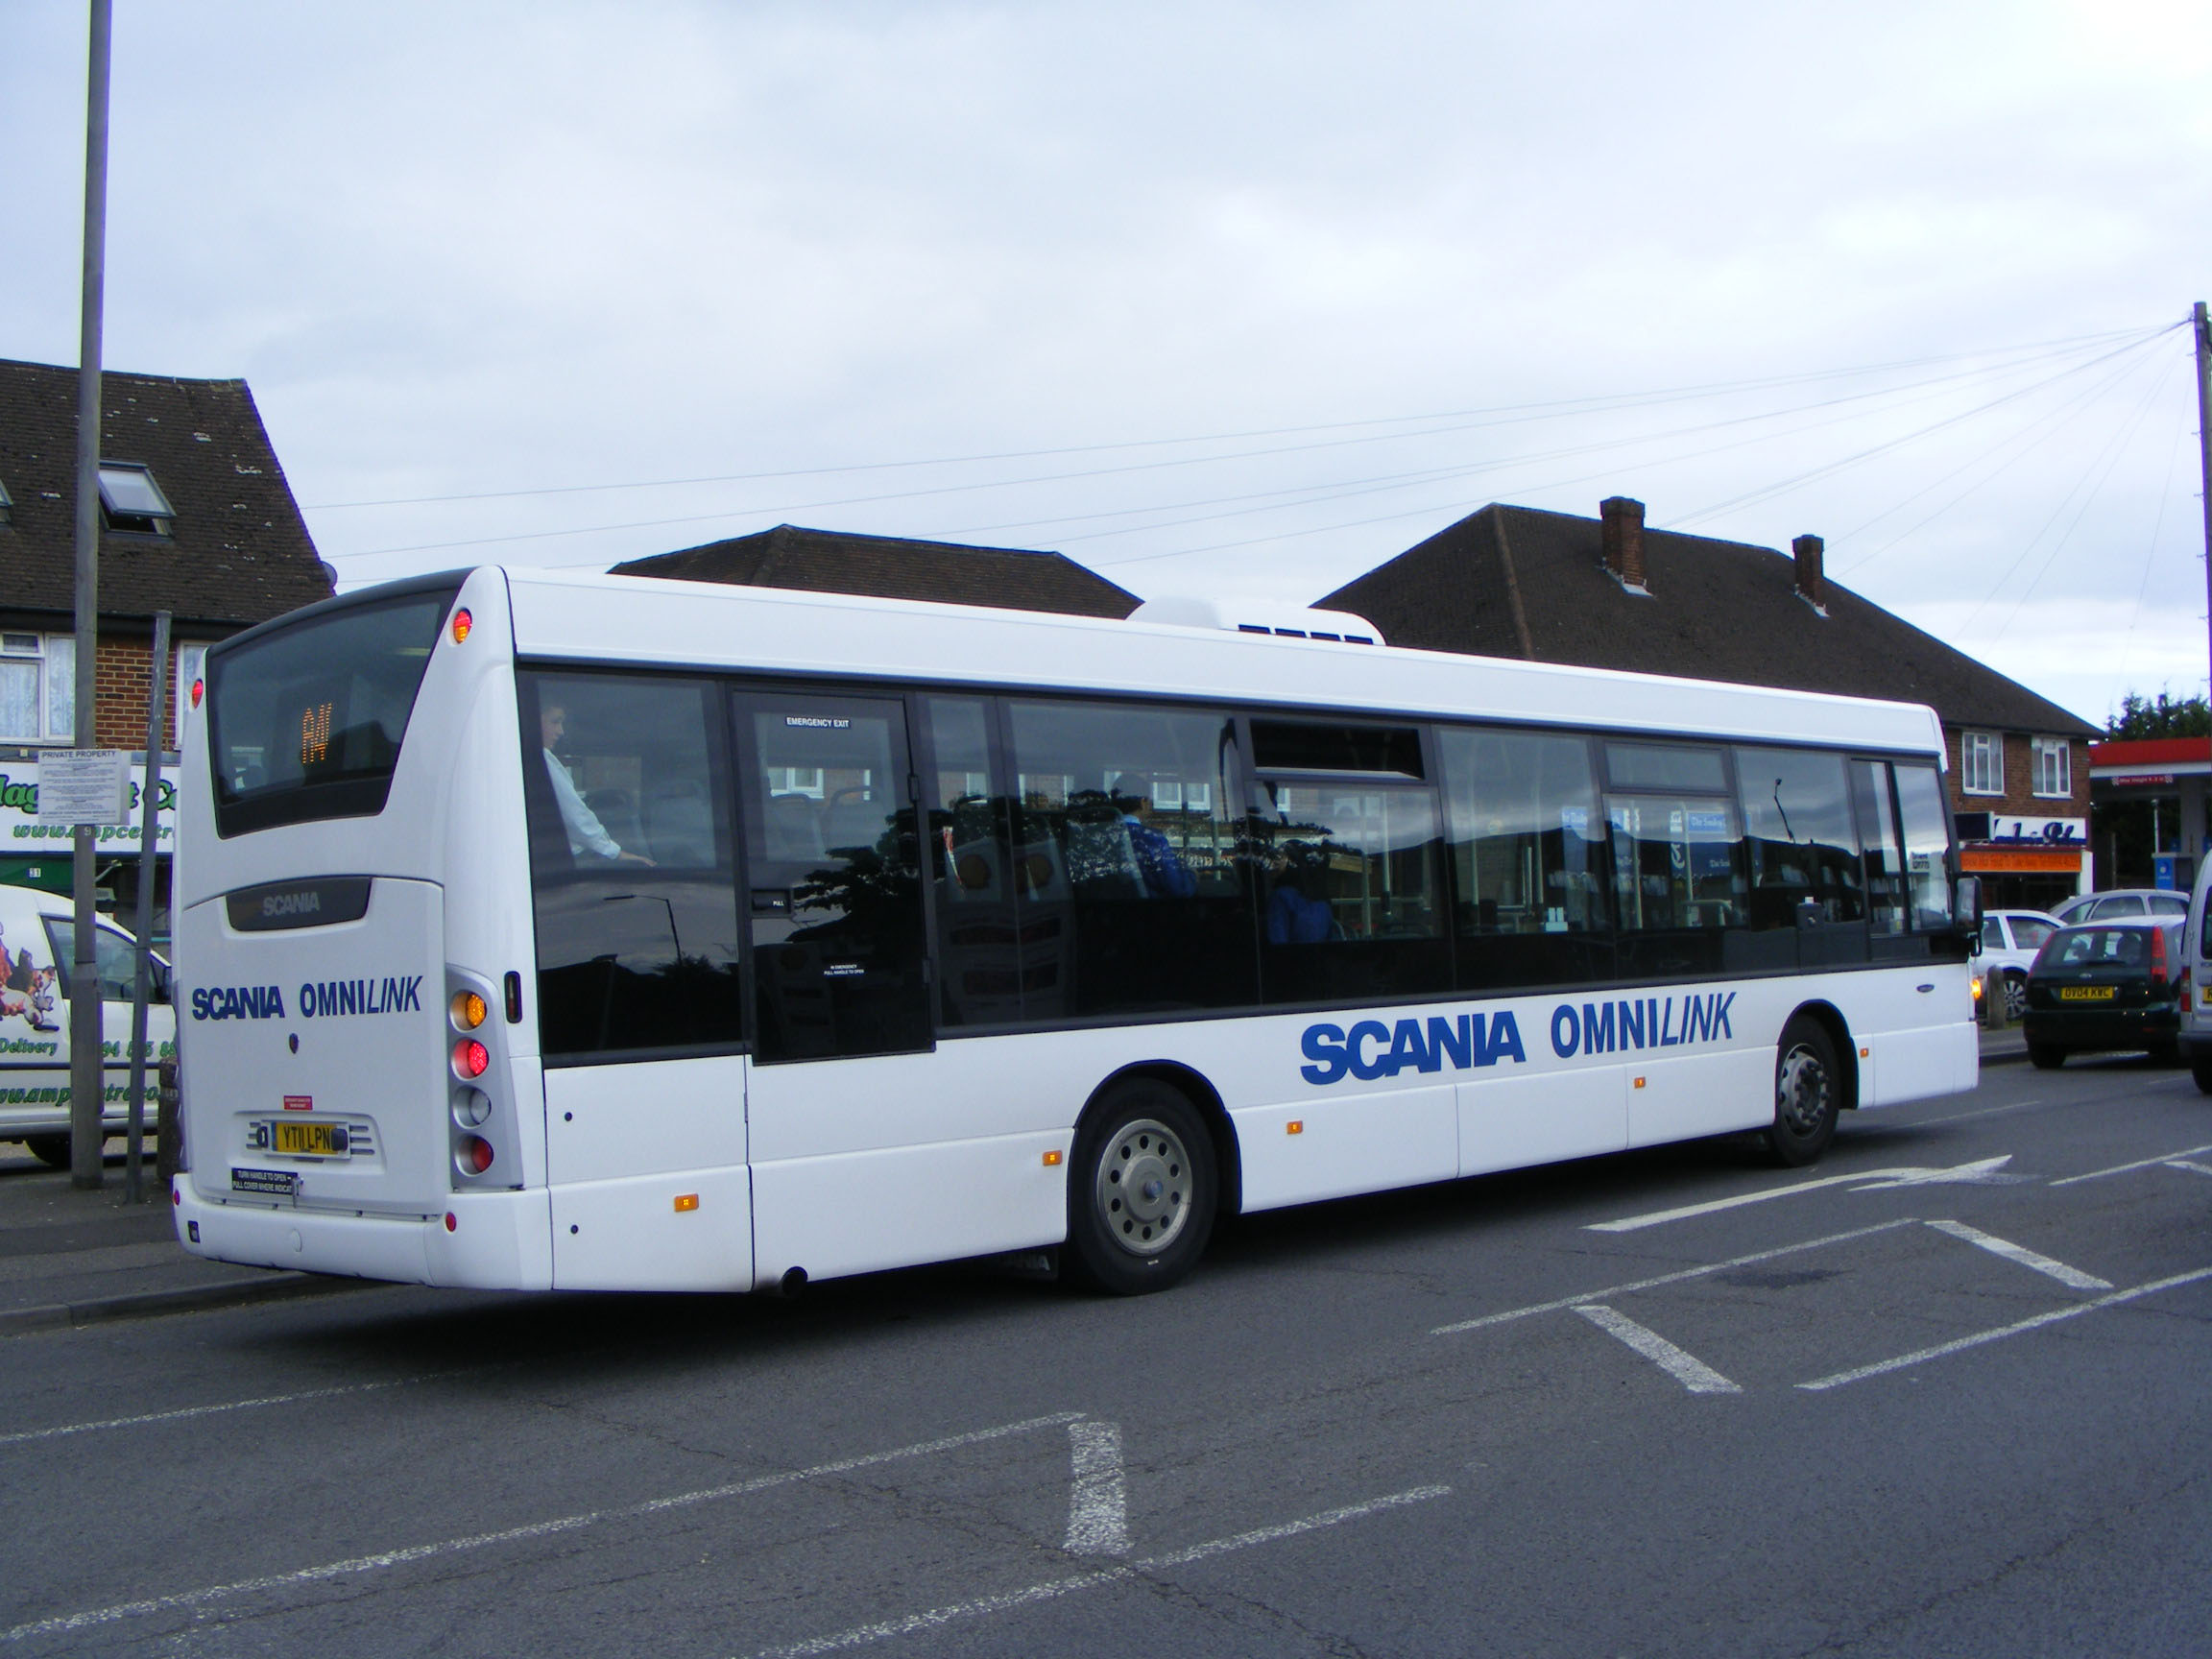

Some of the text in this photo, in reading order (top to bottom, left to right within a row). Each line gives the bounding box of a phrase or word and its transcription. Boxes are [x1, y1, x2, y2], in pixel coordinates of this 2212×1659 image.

[786, 716, 850, 728] EMERGENCY EXIT
[262, 891, 321, 916] SCANIA
[192, 975, 423, 1022] SCANIA OMNILINK
[1300, 992, 1737, 1086] SCANIA OMNILINK
